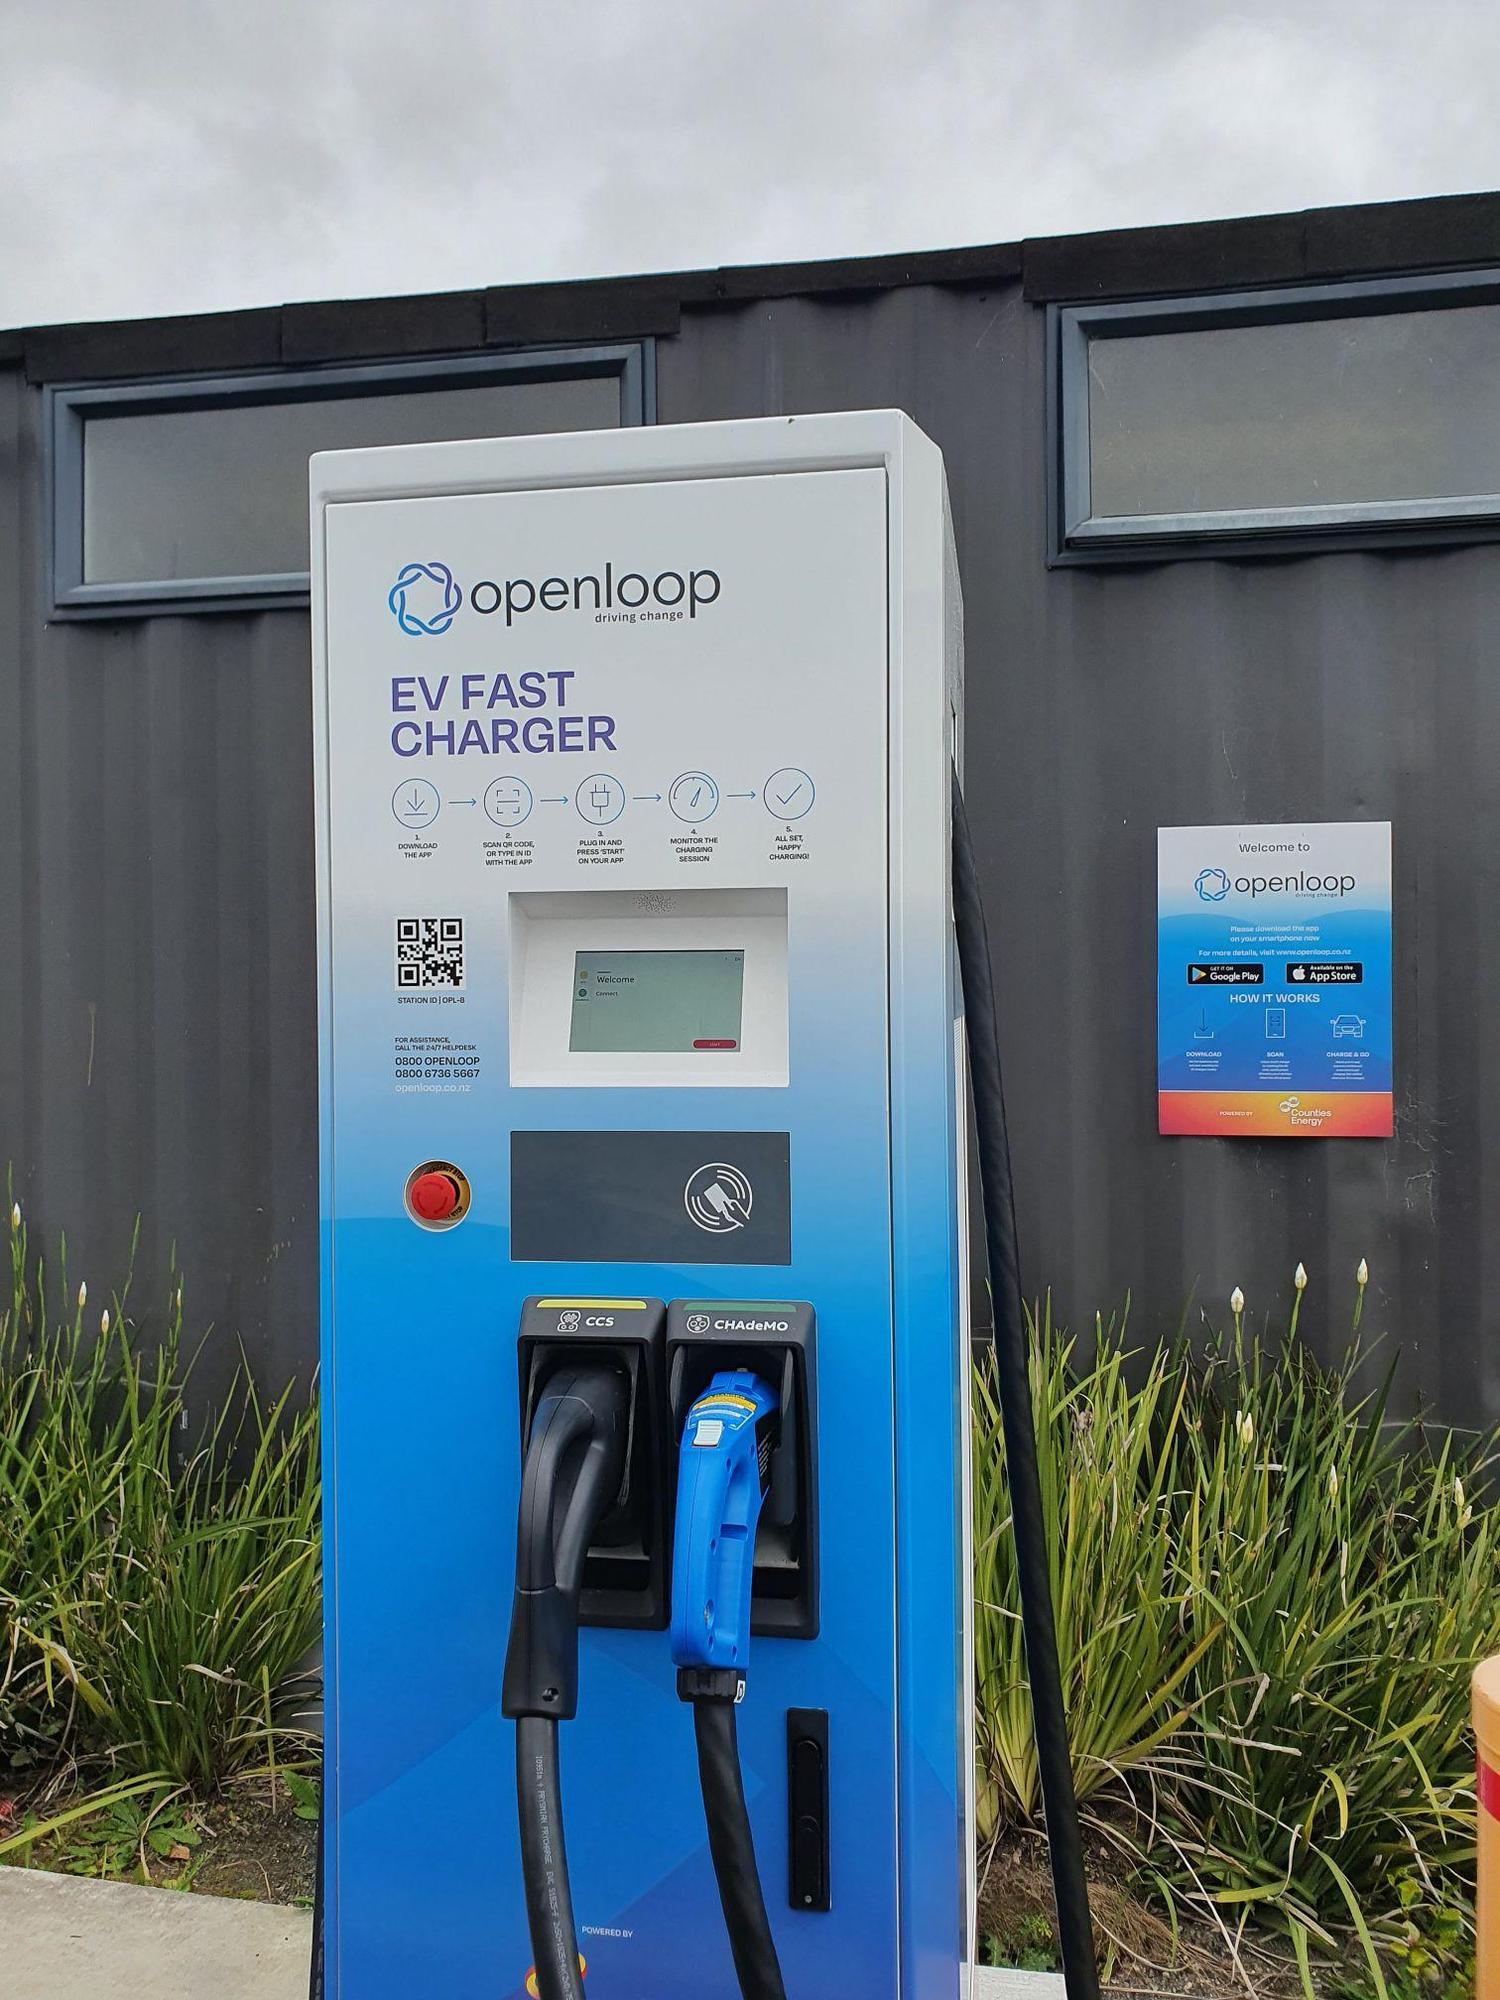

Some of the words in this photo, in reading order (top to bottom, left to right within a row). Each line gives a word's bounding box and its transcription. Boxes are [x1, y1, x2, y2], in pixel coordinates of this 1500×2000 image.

[470, 562, 721, 627] openloop
[595, 611, 636, 624] driving
[640, 610, 684, 623] change
[391, 675, 449, 712] EV
[461, 671, 575, 711] FAST
[391, 715, 618, 757] CHARGER
[789, 834, 804, 842] SET,
[1239, 843, 1295, 853] Welcome
[1298, 843, 1310, 852] to
[1235, 871, 1355, 898] openloop
[1276, 949, 1352, 957] www.openloop.co.nz
[1210, 972, 1240, 982] Google
[1241, 972, 1259, 982] Play
[1310, 972, 1330, 982] App
[1331, 971, 1357, 980] Store
[1230, 994, 1259, 1003] HOW
[1262, 994, 1273, 1003] IT
[1276, 993, 1320, 1003] WORKS
[395, 1057, 422, 1066] 0800
[425, 1057, 480, 1066] OPENLOOP
[395, 1069, 422, 1078] 0800
[424, 1069, 451, 1078] 6736
[453, 1069, 480, 1078] 5667
[394, 1083, 472, 1093] openloop.co.nz
[1291, 1108, 1332, 1117] Counties
[1291, 1117, 1323, 1126] Energy
[585, 1316, 615, 1327] CCS
[714, 1319, 789, 1331] CHAdeMO
[581, 1926, 621, 1937] POWERED
[622, 1929, 633, 1938] BY
